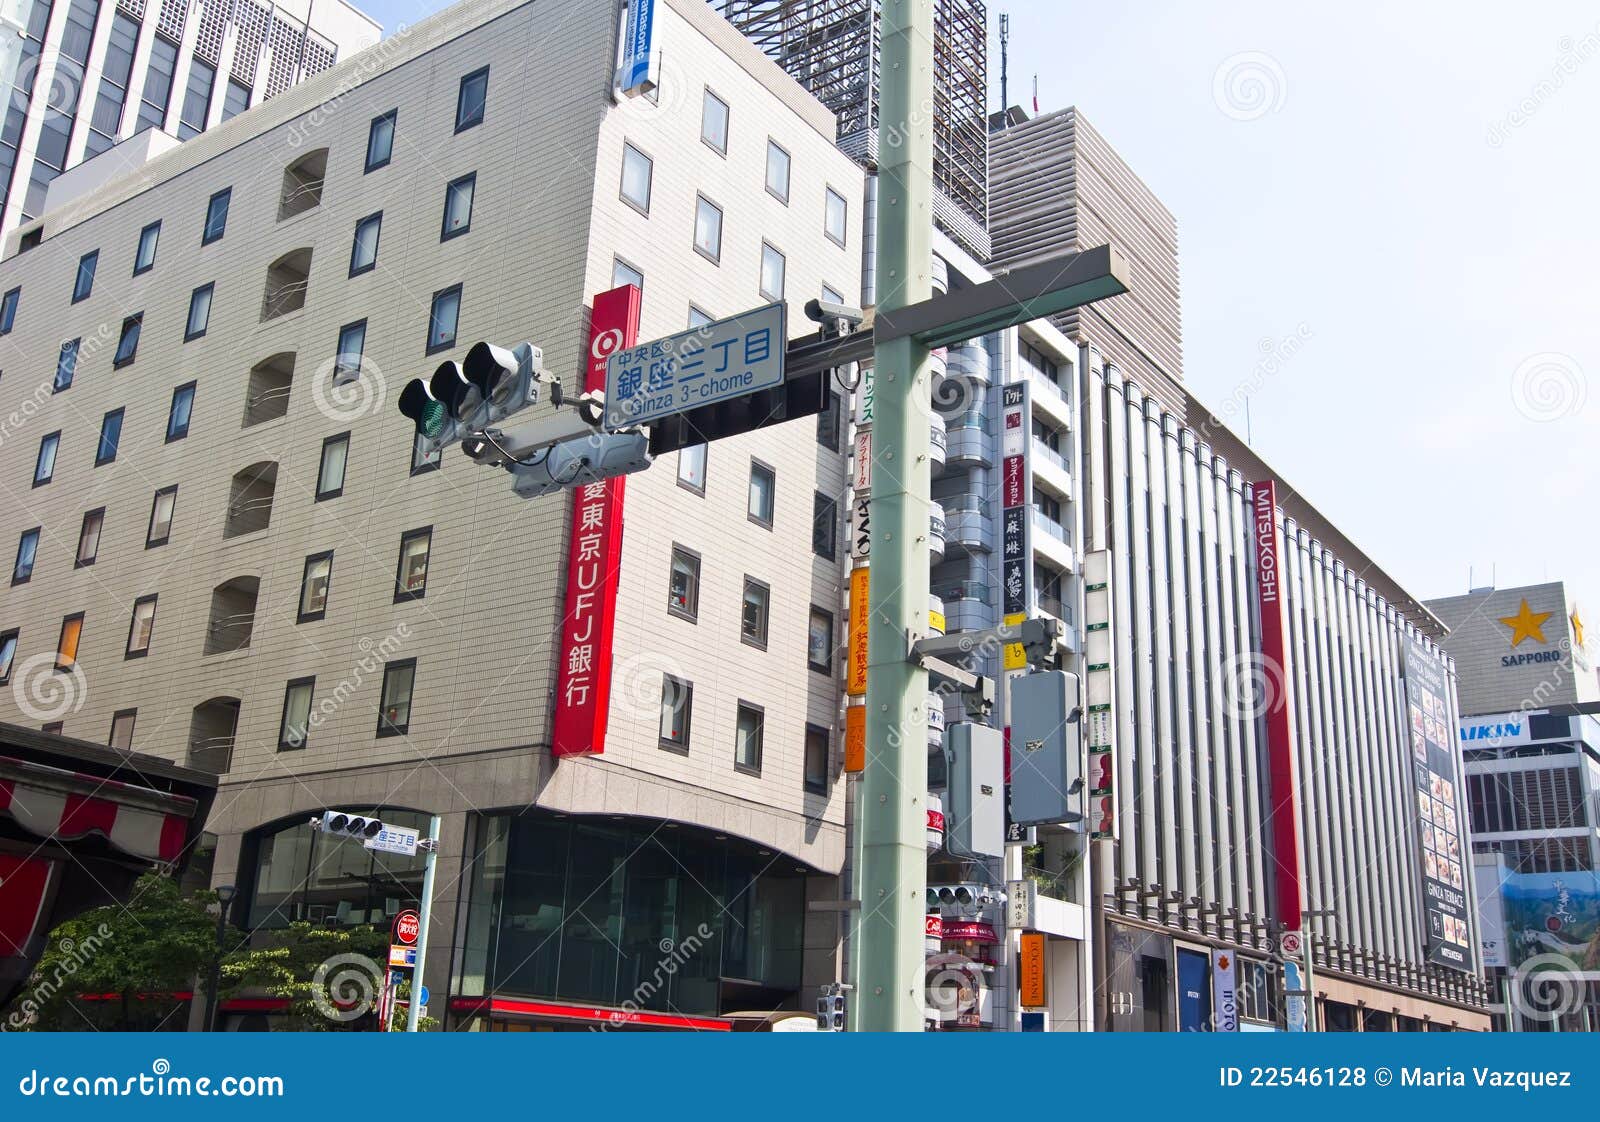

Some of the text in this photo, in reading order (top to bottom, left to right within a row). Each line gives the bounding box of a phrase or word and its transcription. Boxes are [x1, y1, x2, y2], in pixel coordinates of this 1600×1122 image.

[616, 327, 771, 401] 銀座三丁目
[618, 344, 665, 368] 中央区
[630, 371, 754, 416] Ginza 3-chome
[1256, 488, 1276, 602] MITSUKOSHI
[1501, 650, 1560, 668] SAPPORO
